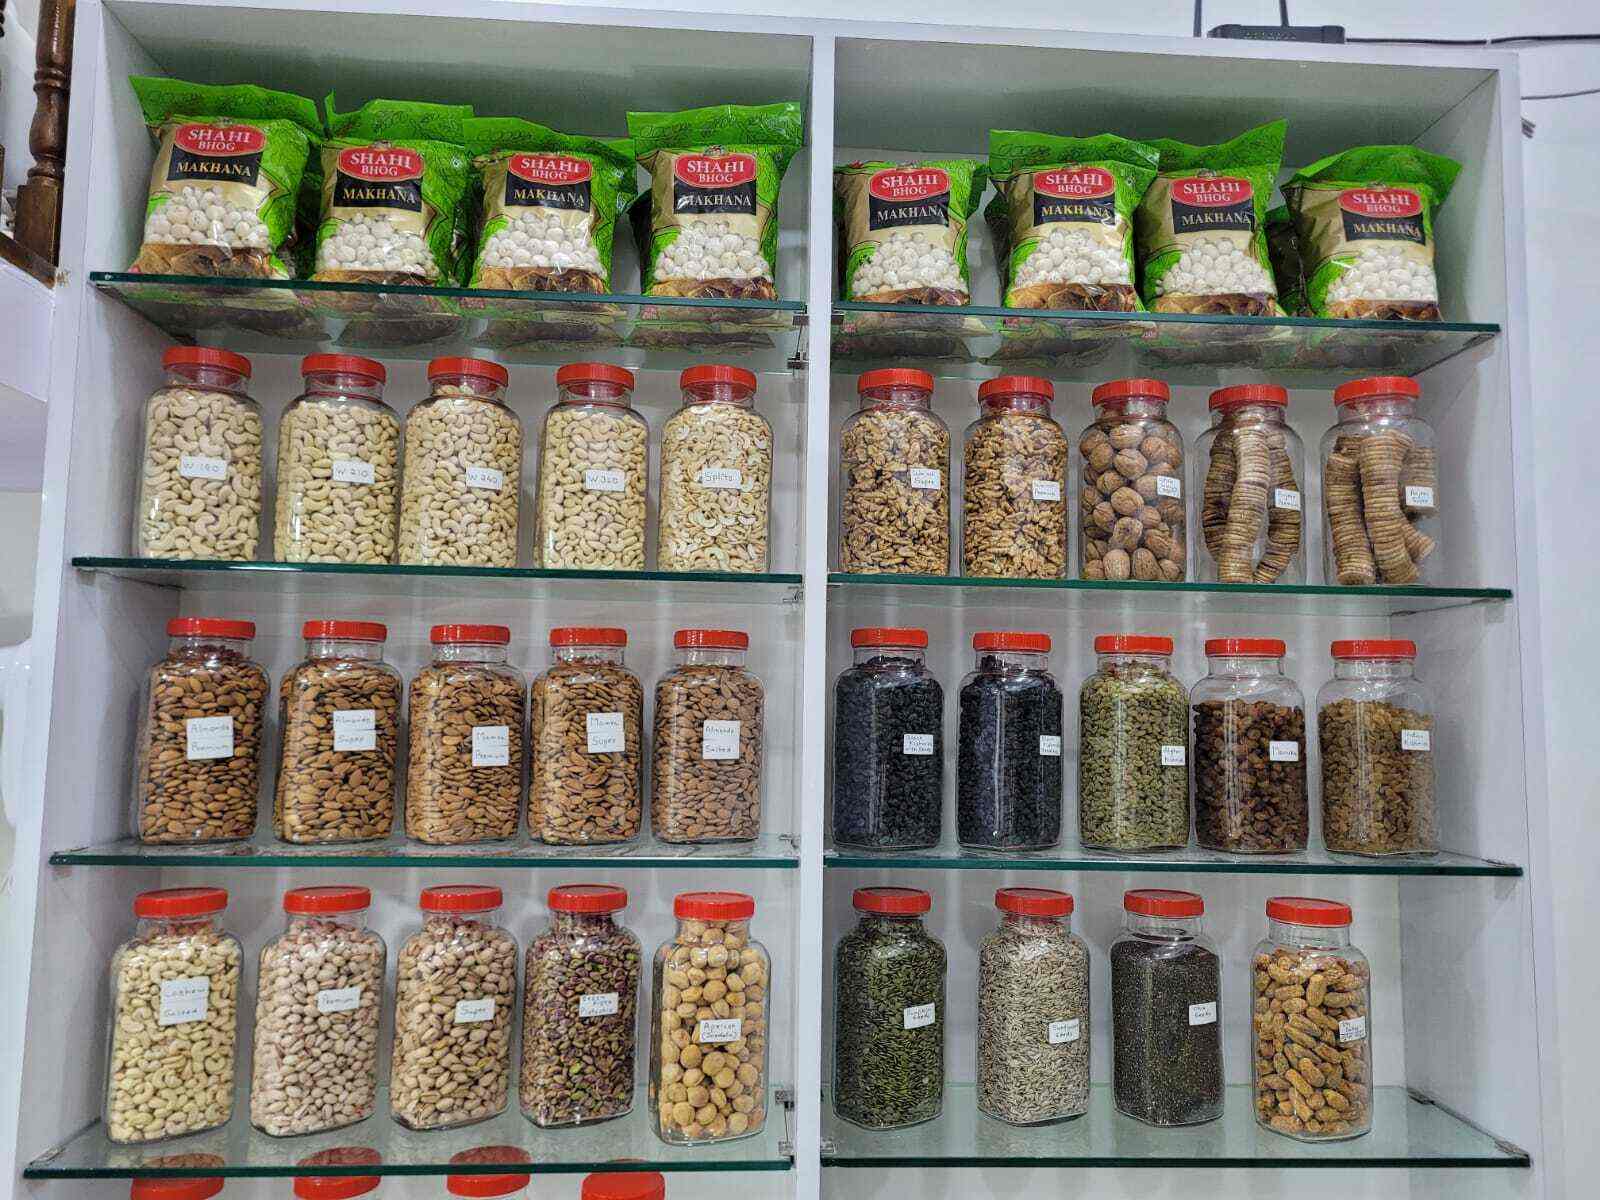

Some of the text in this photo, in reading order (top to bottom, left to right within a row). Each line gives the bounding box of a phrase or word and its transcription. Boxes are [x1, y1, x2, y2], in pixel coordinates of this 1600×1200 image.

[187, 129, 250, 143] SHAHI
[198, 140, 236, 151] BHOG
[350, 152, 412, 169] SHAHI
[520, 157, 582, 174] SHAHI
[687, 160, 744, 174] SHAHI
[176, 160, 251, 177] MAKHANA
[361, 165, 398, 177] BHOG
[532, 169, 567, 181] BHOG
[699, 172, 733, 183] BHOG
[881, 174, 938, 188] SHAHI
[1045, 172, 1103, 186] SHAHI
[893, 185, 928, 196] BHOG
[1057, 183, 1092, 194] BHOG
[1183, 181, 1240, 195] SHAHI
[342, 187, 416, 204] MAKHANA
[514, 188, 585, 206] MAKHANA
[677, 193, 752, 210] MAKHANA
[1196, 191, 1231, 202] BHOG
[1352, 192, 1410, 206] SHAHI
[877, 205, 944, 223] MAKHANA
[1041, 204, 1111, 219] MAKHANA
[1365, 203, 1401, 213] BHOG
[1181, 210, 1251, 226] MAKHANA
[1353, 222, 1421, 237] MAKHANA
